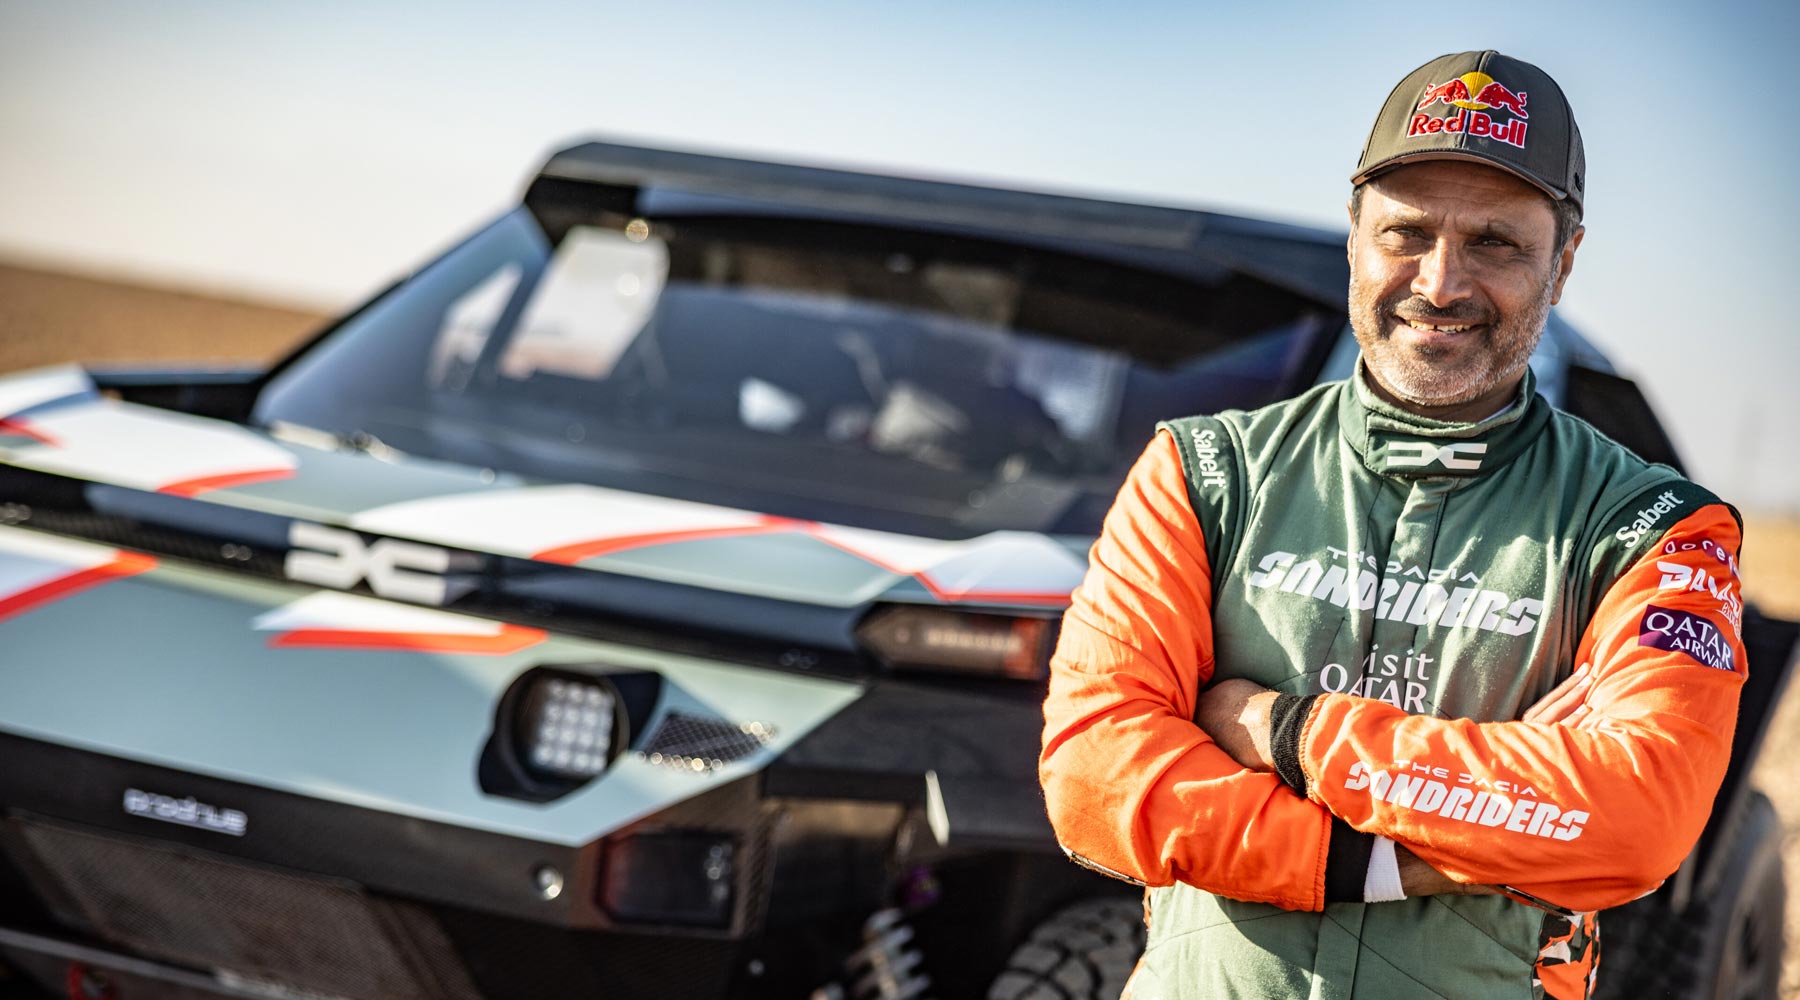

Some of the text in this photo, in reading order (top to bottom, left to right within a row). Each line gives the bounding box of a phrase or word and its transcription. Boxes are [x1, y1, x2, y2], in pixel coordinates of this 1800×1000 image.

[1407, 108, 1528, 149] Red Bull
[1191, 428, 1226, 488] Sabelt
[1615, 490, 1684, 548] Sabelt
[1249, 551, 1544, 637] SANDRIDERS
[1646, 612, 1734, 670] QATAR
[1344, 760, 1591, 842] SANDRIDERS
[1393, 759, 1538, 798] THE DACIA
